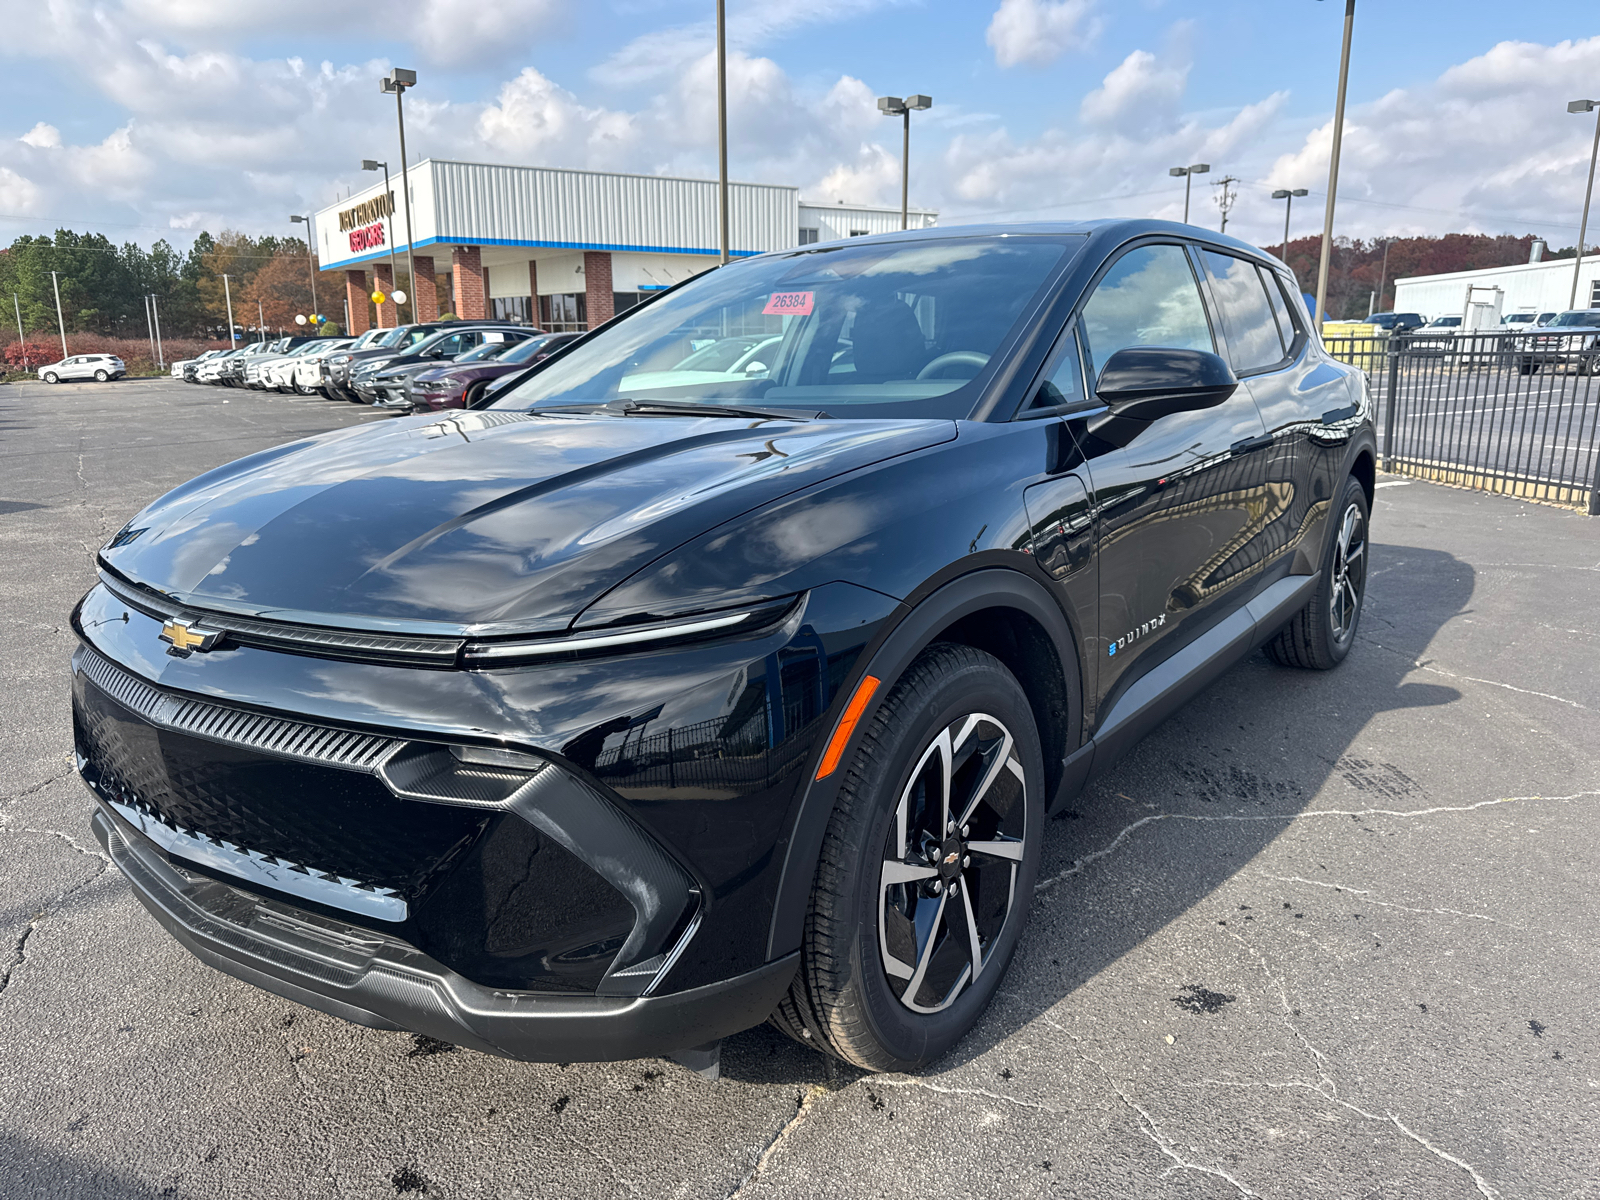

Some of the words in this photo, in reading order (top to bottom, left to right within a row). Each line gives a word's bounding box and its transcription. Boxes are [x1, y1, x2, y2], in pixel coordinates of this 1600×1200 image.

[348, 228, 366, 253] USED
[364, 222, 385, 248] CARS
[772, 294, 806, 308] 26384
[1108, 613, 1166, 657] EQUINOX
[861, 862, 875, 918] 245/55
[869, 844, 877, 856] R
